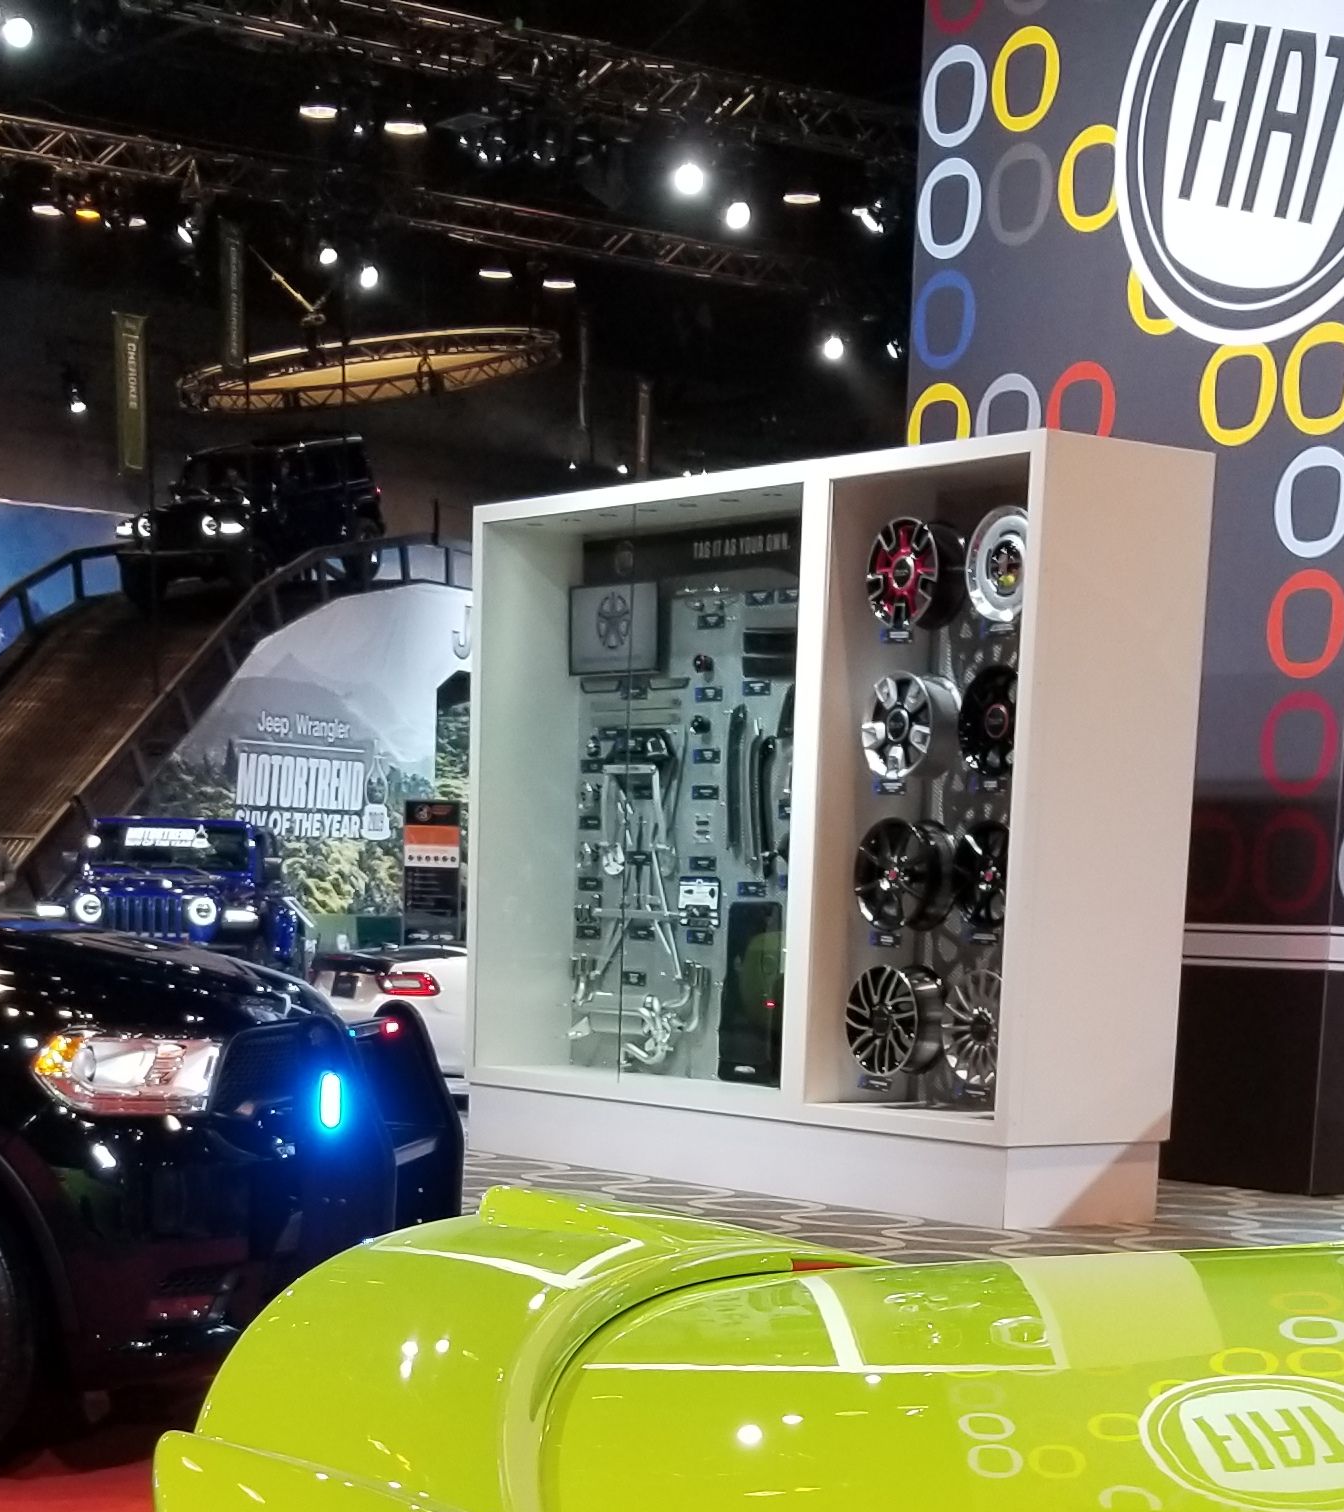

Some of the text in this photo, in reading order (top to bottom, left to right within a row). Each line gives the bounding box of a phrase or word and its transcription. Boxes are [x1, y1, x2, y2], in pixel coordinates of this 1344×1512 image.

[257, 711, 351, 743] Jeep Wrangler
[236, 752, 365, 811] MOTORTREND
[268, 811, 292, 836] OF
[293, 812, 322, 838] THE
[321, 813, 360, 839] YEAR
